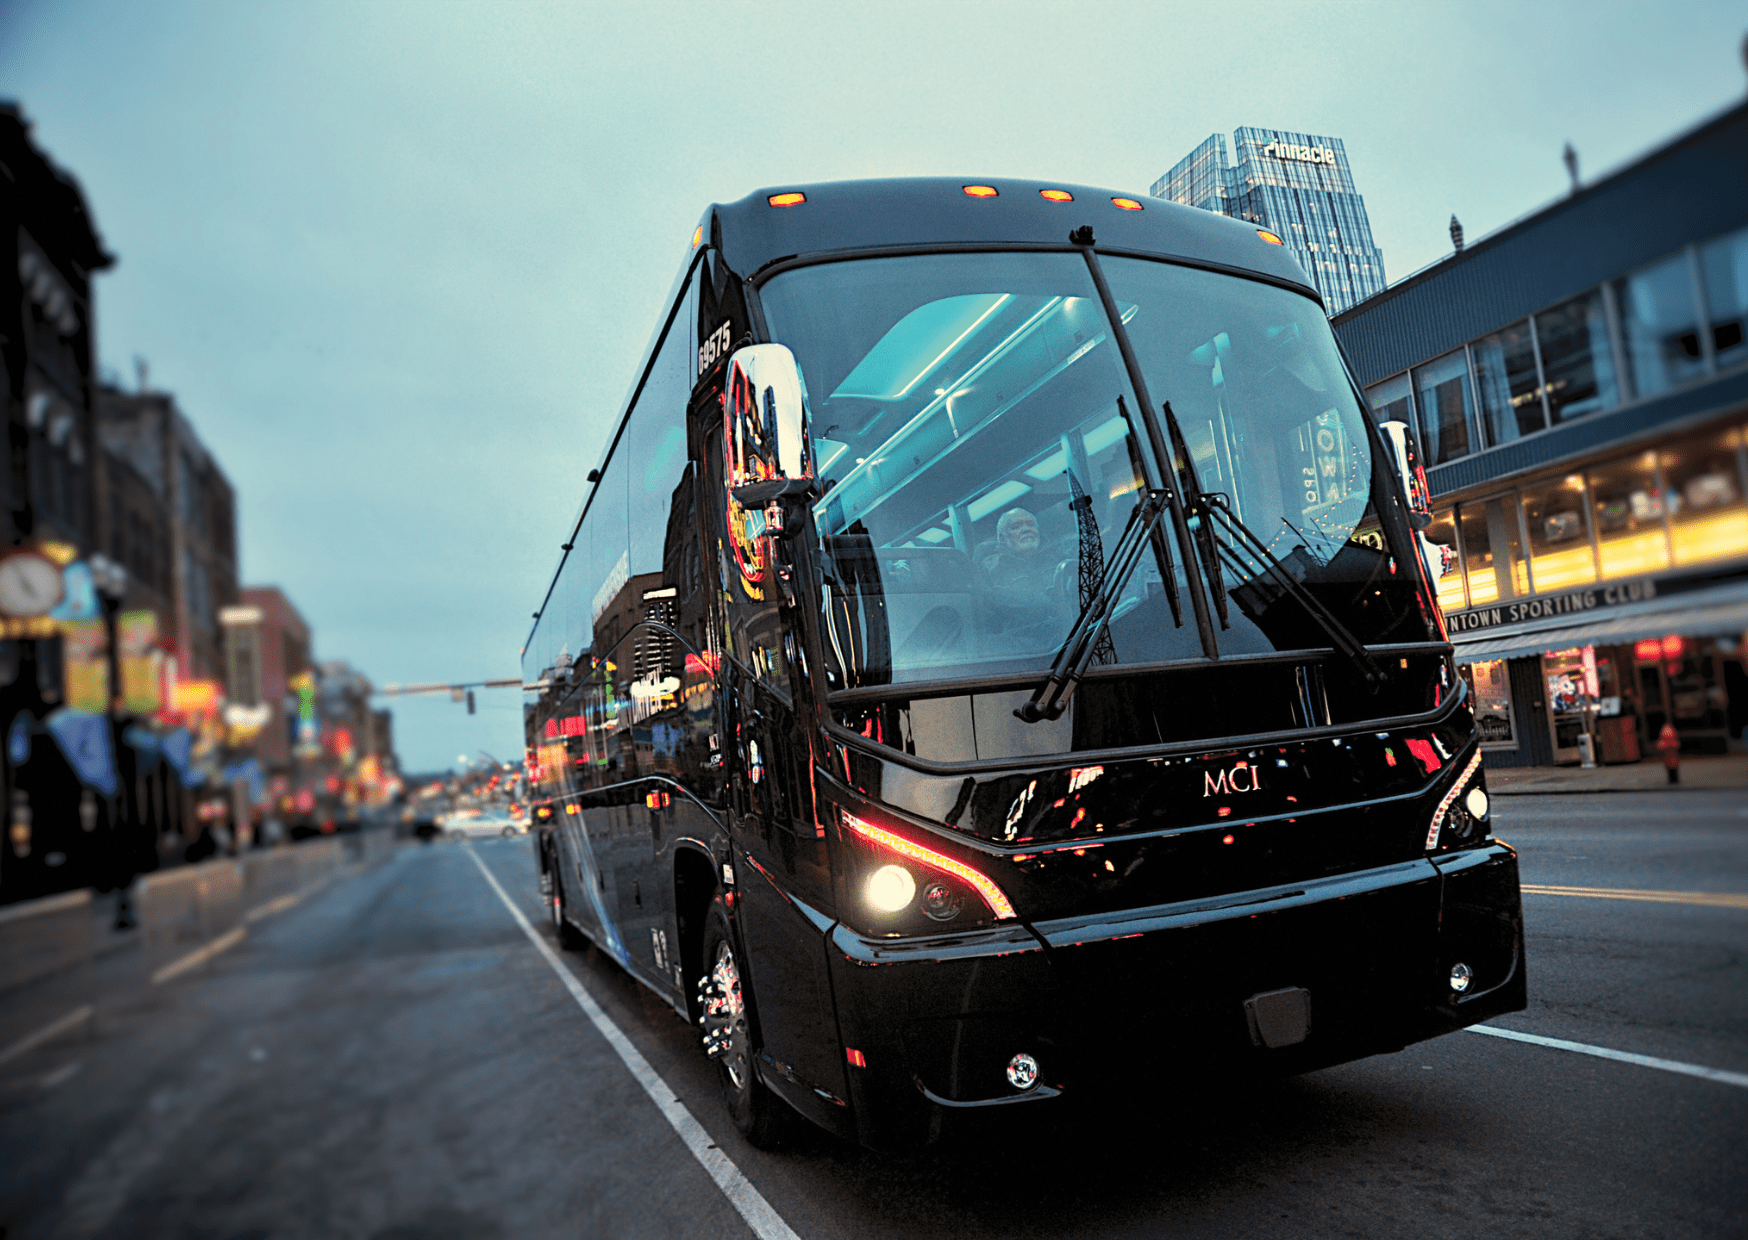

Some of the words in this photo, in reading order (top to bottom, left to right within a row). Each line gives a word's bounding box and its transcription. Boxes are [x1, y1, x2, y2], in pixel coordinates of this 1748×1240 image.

[1262, 137, 1335, 164] Pinnacle
[698, 320, 731, 375] 69575
[1510, 592, 1597, 621] SPORTING
[1604, 581, 1656, 605] CLUB
[1203, 765, 1262, 797] MCI
